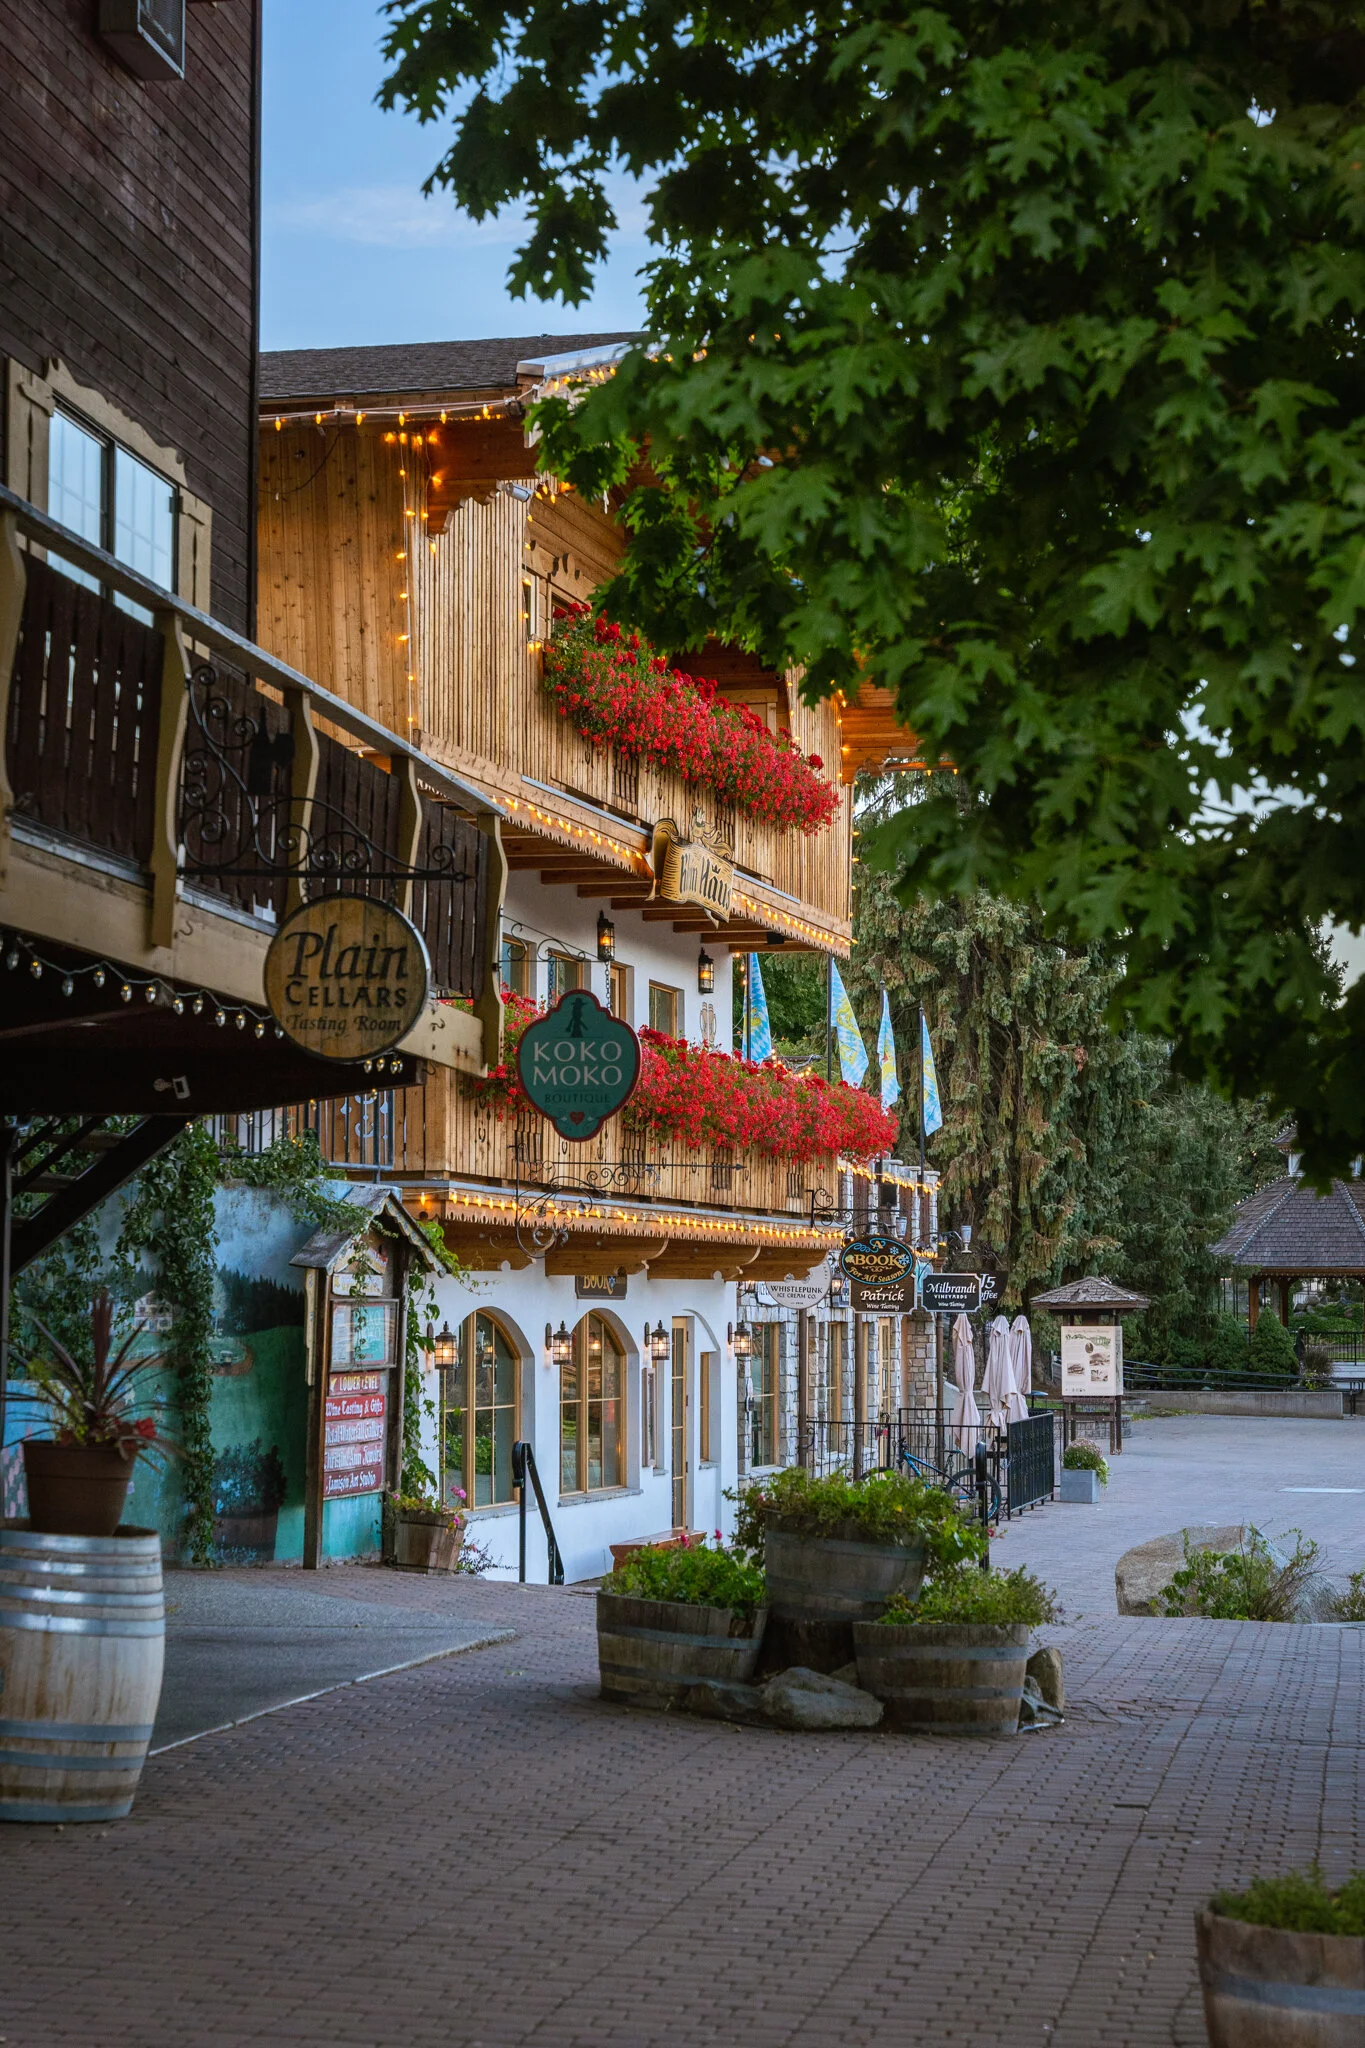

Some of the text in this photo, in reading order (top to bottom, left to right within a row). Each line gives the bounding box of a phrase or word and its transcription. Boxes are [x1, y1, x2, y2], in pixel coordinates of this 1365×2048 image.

[284, 923, 409, 980] Plain
[284, 981, 408, 1009] CELLARS
[286, 1013, 401, 1036] Tasting Room
[533, 1041, 622, 1062] KOKO
[533, 1065, 623, 1087] MOKO
[544, 1093, 611, 1103] BOUTIQUE
[873, 1240, 884, 1249] A
[853, 1254, 907, 1269] BOOK
[848, 1266, 906, 1282] For All Seasons
[771, 1285, 823, 1294] WHISTLEPUNK
[860, 1288, 905, 1301] Patrick
[926, 1281, 976, 1294] Milbrandt
[980, 1290, 998, 1301] offee
[339, 1375, 378, 1391] LOWER LEVEL
